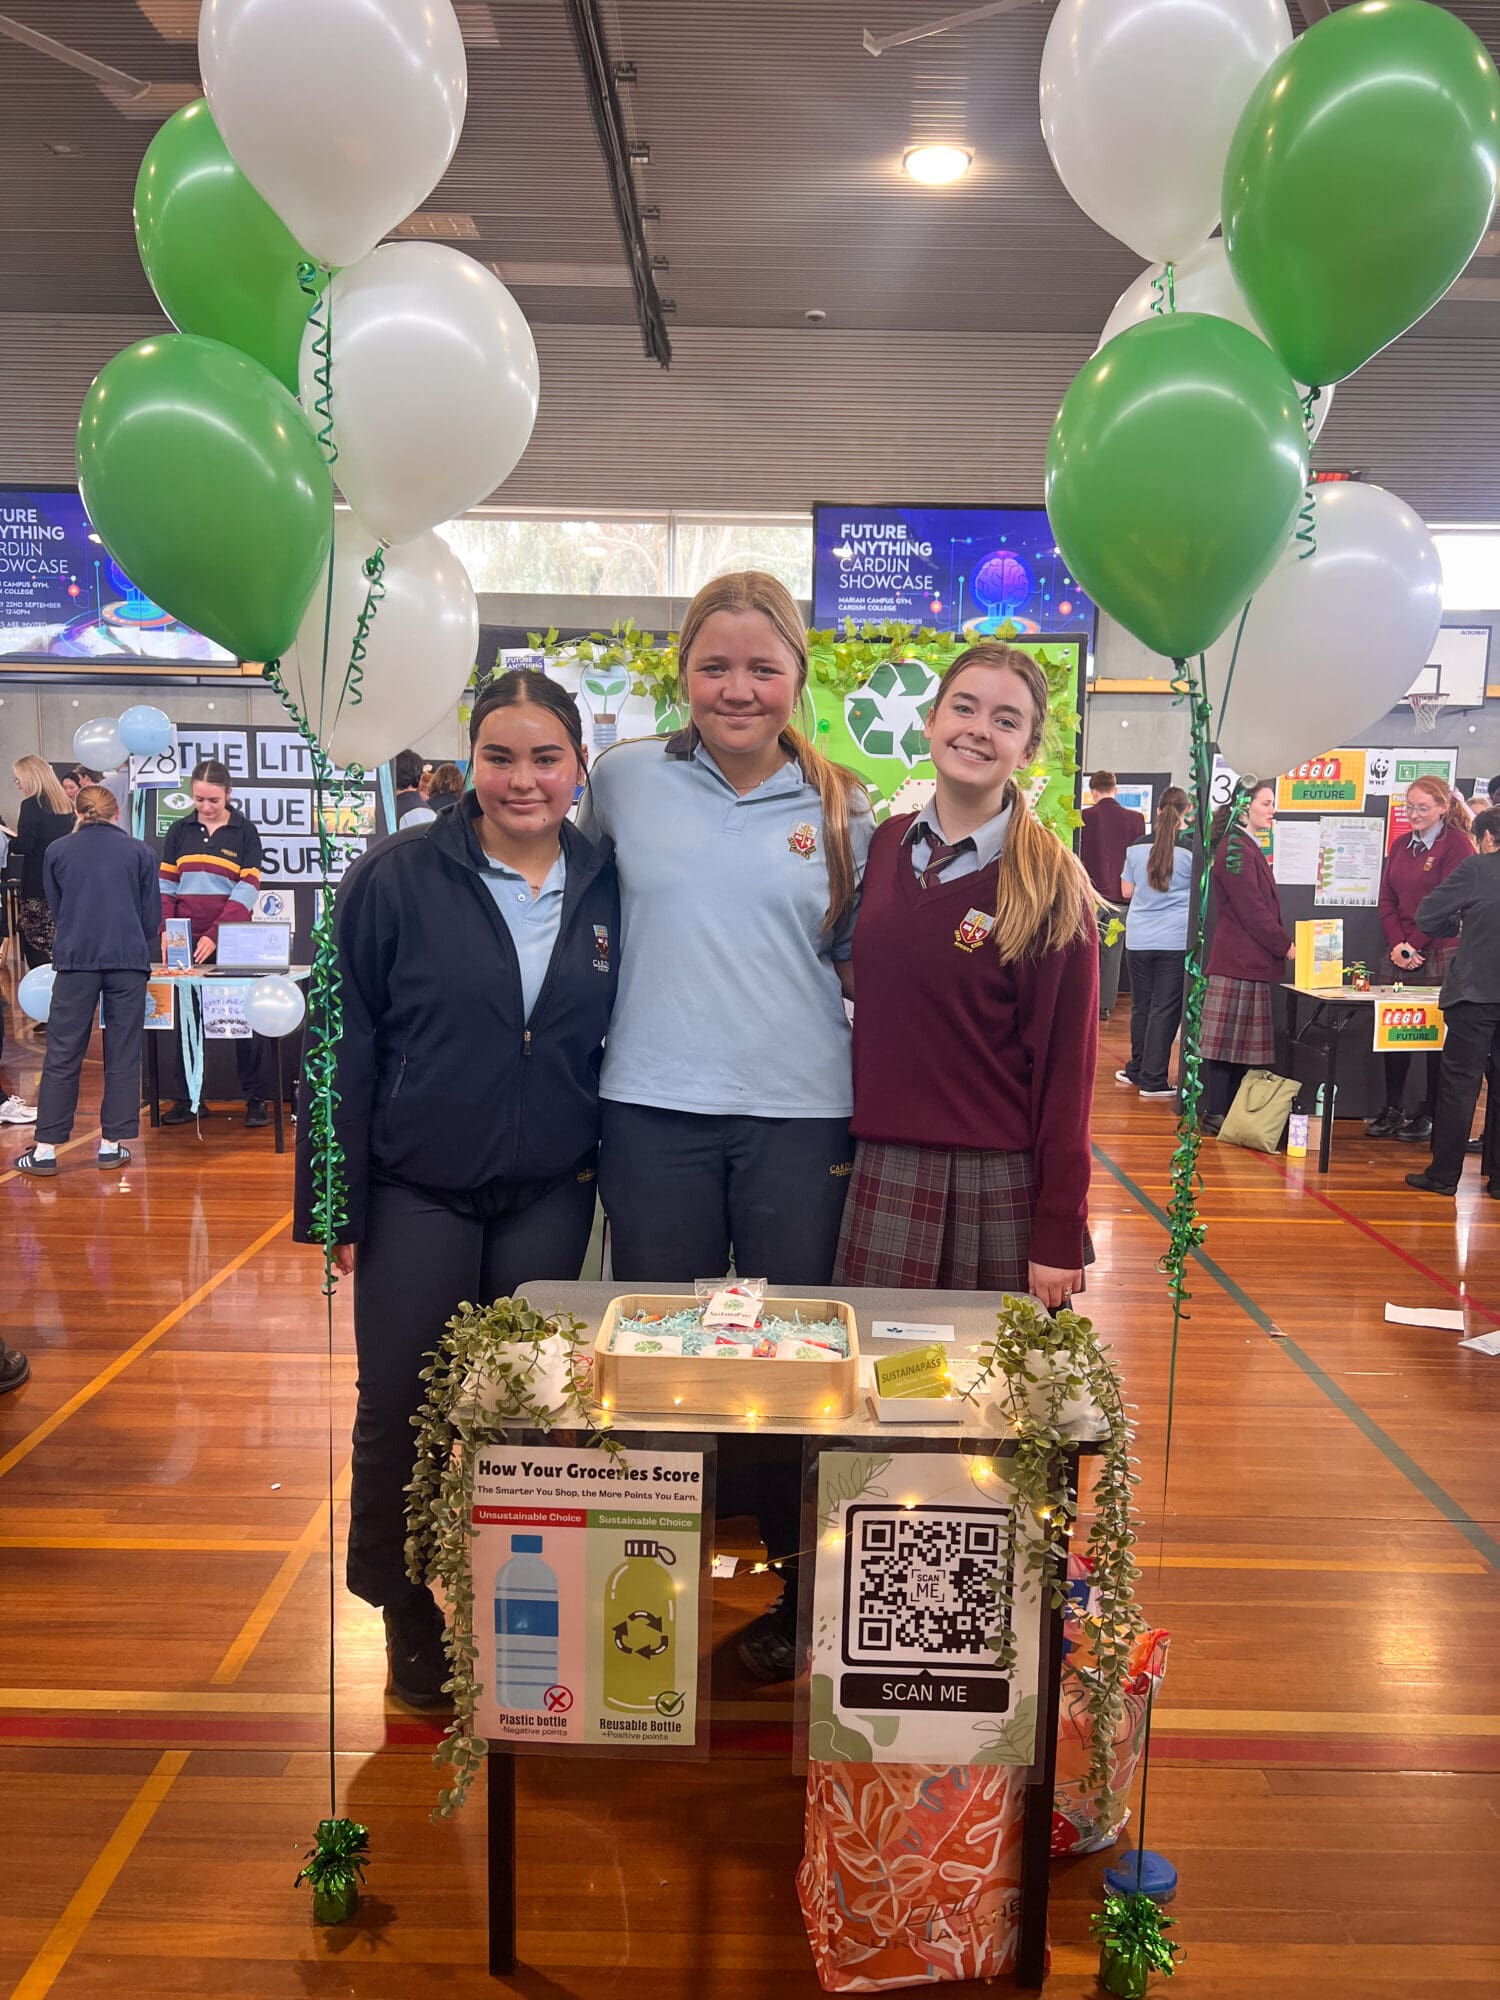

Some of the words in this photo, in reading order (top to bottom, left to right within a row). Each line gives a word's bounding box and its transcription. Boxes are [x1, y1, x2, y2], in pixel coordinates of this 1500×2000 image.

[0, 508, 37, 523] URE
[841, 523, 907, 539] FUTURE
[841, 540, 933, 557] ANYTHING
[840, 557, 910, 573] CARDIJN
[839, 574, 934, 590] SHOWCASE
[24, 601, 62, 609] SEPTEMBER
[866, 597, 895, 605] CAMPUS
[507, 656, 533, 664] FUTURE
[508, 662, 544, 671] ANYTHING
[137, 744, 177, 775] 28
[178, 742, 243, 772] THE
[1287, 763, 1335, 778] LEGO
[1302, 790, 1345, 799] FUTURE
[1383, 1011, 1423, 1026] LEGO
[1396, 1033, 1430, 1041] FUTURE
[880, 1358, 942, 1384] SUSTAINAPASS
[478, 1460, 517, 1477] How
[520, 1461, 563, 1478] Your
[566, 1463, 649, 1481] Groceries
[652, 1466, 700, 1483] Score
[477, 1485, 494, 1494] The
[495, 1486, 535, 1496] Smarter
[536, 1487, 553, 1496] You
[555, 1488, 580, 1498] Shop,
[582, 1489, 597, 1498] the
[599, 1490, 622, 1498] More
[624, 1491, 653, 1500] Points
[655, 1492, 672, 1501] You
[674, 1492, 698, 1502] Earn.
[479, 1510, 549, 1521] Unsustainable
[549, 1512, 582, 1523] Choice
[598, 1514, 658, 1525] Sustainable
[659, 1517, 693, 1527] Choice
[917, 1573, 940, 1583] SCAN
[916, 1582, 940, 1599] ME
[881, 1682, 933, 1702] SCAN
[940, 1685, 968, 1703] ME
[500, 1713, 534, 1727] Plastic
[537, 1715, 568, 1728] bottle
[600, 1718, 648, 1732] Reusable
[650, 1720, 682, 1733] Bottle
[501, 1726, 541, 1736] -Negative
[542, 1728, 568, 1738] points
[602, 1731, 641, 1741] +Positive
[642, 1733, 669, 1742] points
